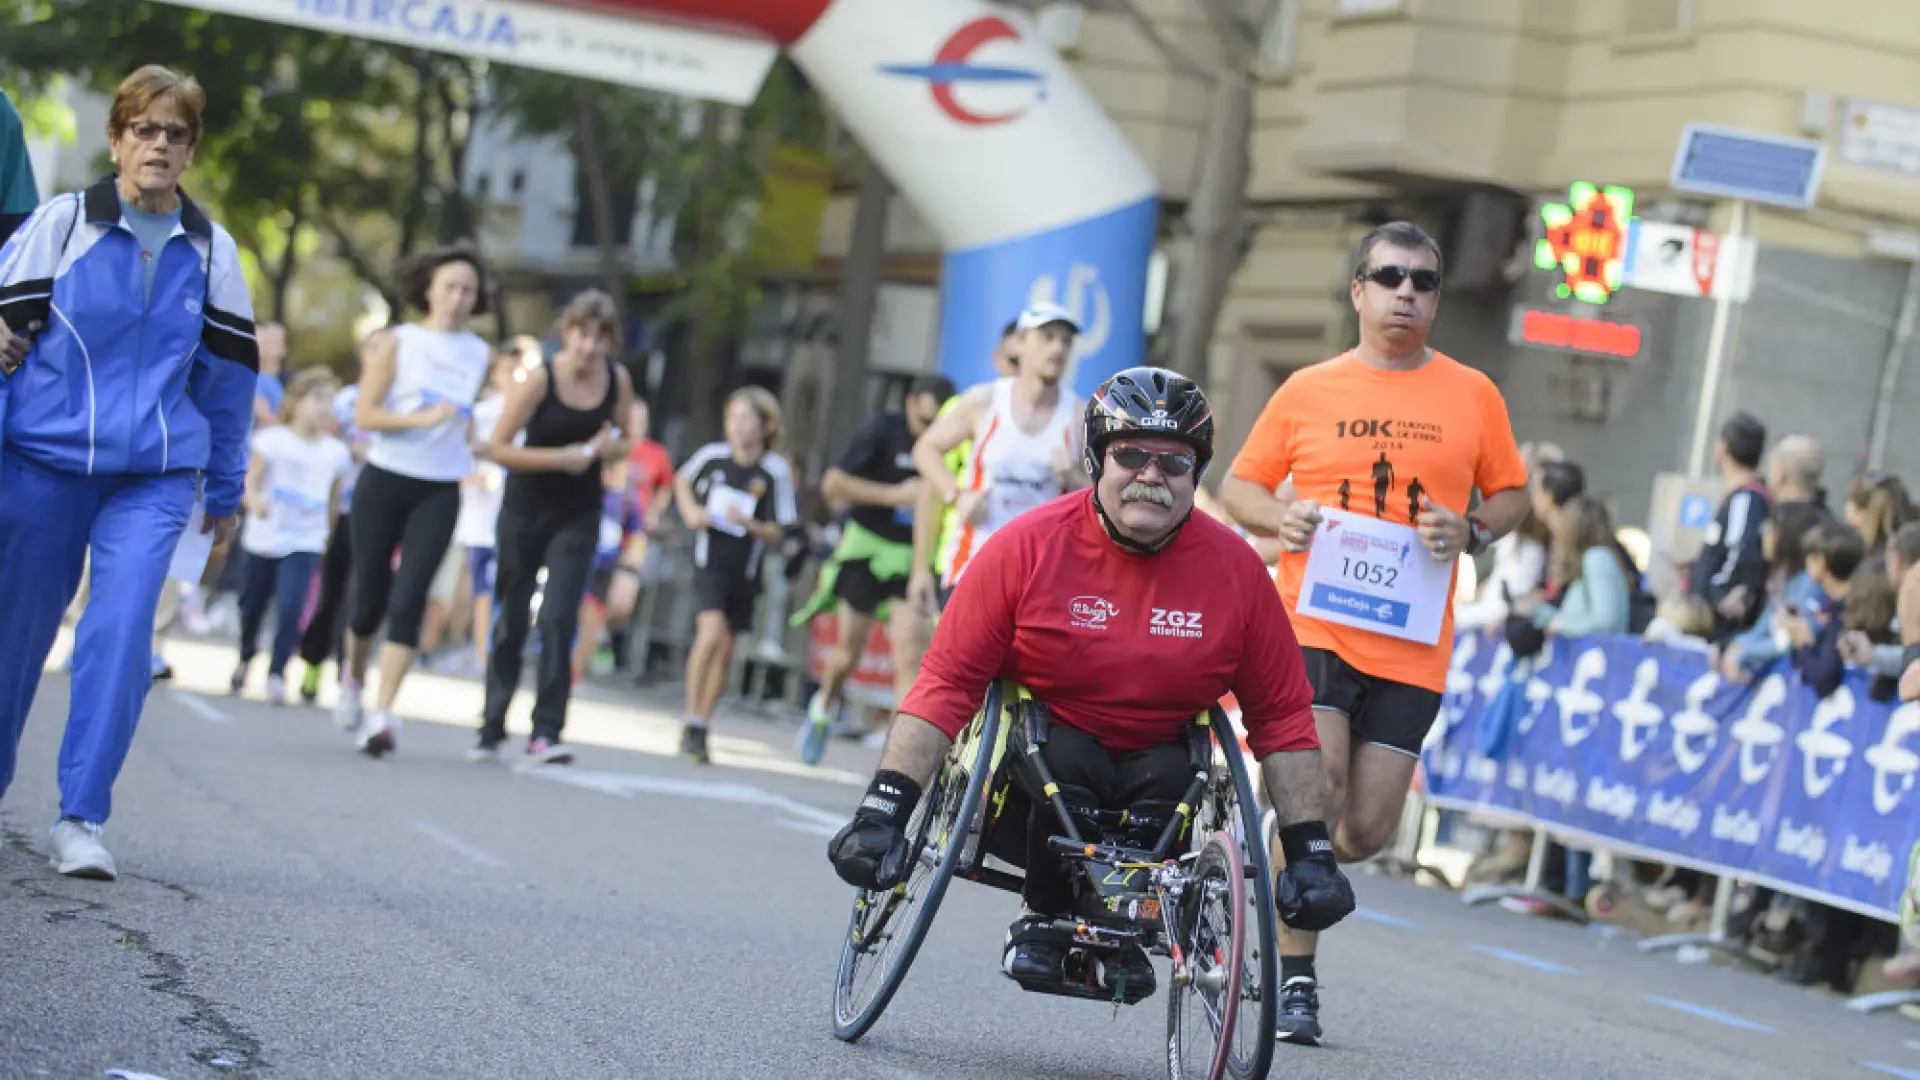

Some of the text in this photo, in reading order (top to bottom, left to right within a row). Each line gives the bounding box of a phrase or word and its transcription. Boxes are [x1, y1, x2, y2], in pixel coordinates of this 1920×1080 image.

[1336, 418, 1393, 438] 10K
[1342, 556, 1399, 588] 1052
[1150, 607, 1203, 627] ZGZ
[1149, 625, 1203, 638] atletismo
